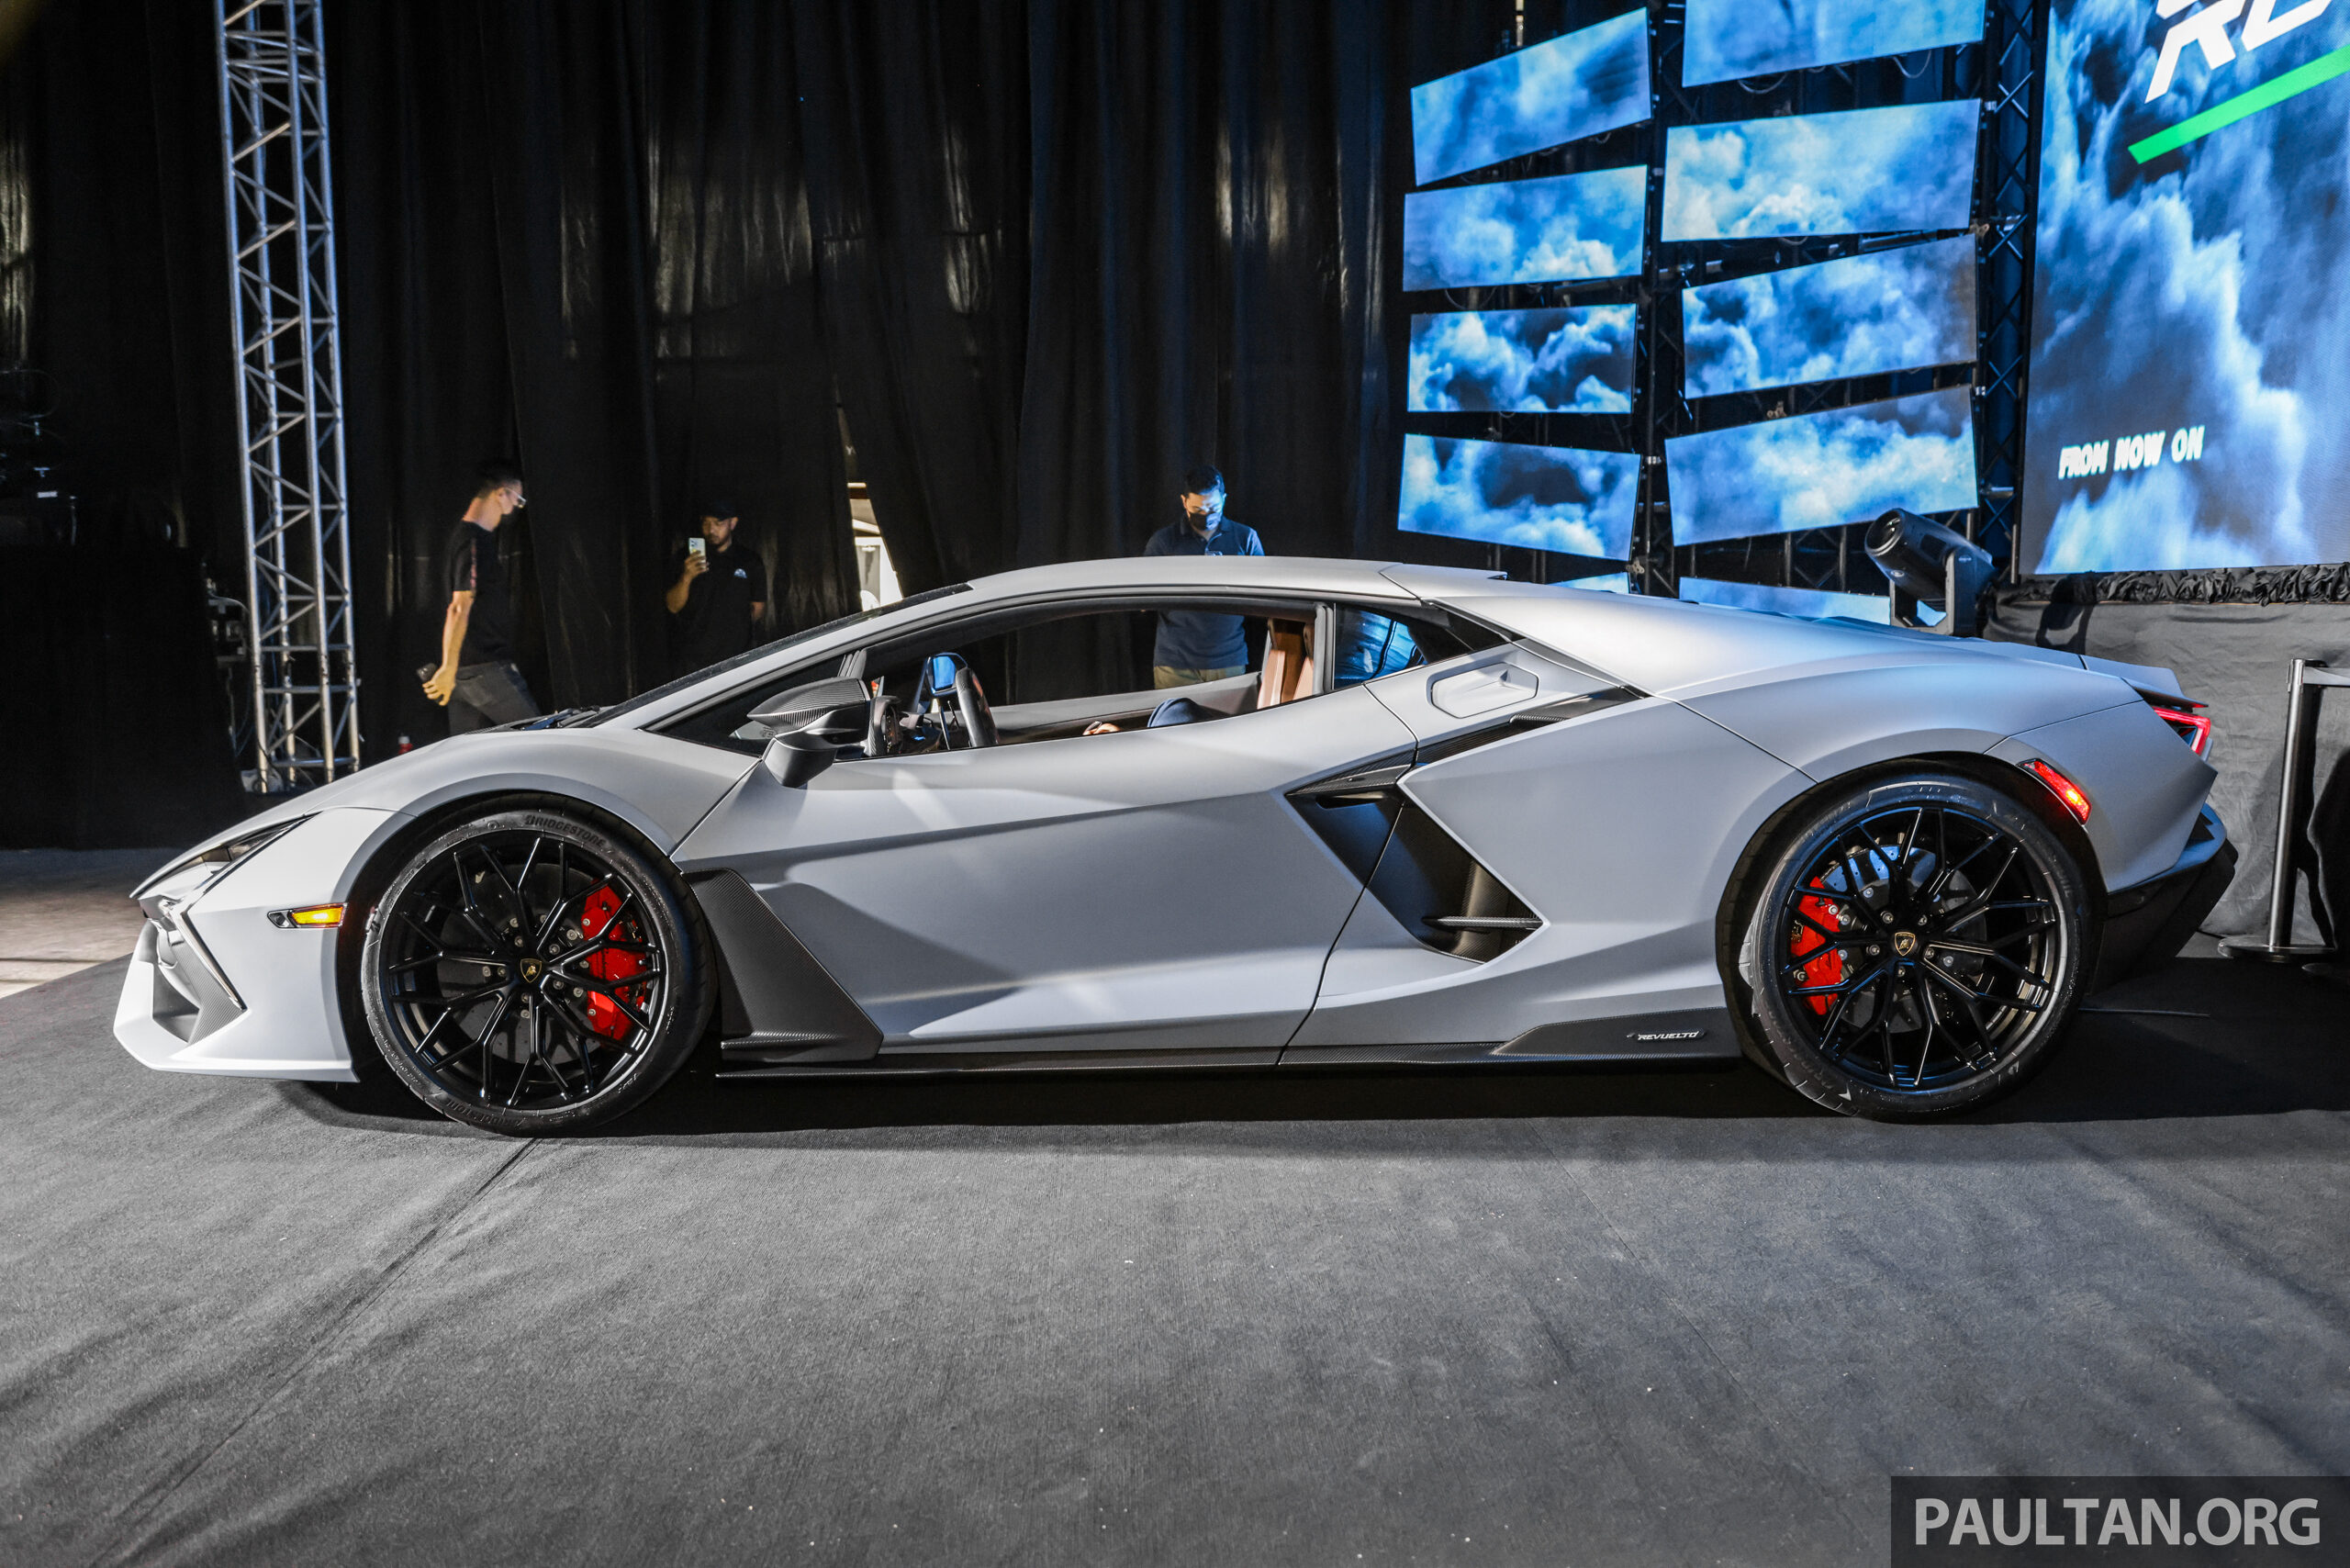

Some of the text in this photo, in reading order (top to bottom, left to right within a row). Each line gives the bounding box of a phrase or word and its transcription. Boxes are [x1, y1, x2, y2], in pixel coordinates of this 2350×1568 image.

[2058, 424, 2205, 480] FROM NOW ON
[524, 814, 607, 847] BRIDGESTONE
[1637, 1030, 1700, 1041] REVUELTO
